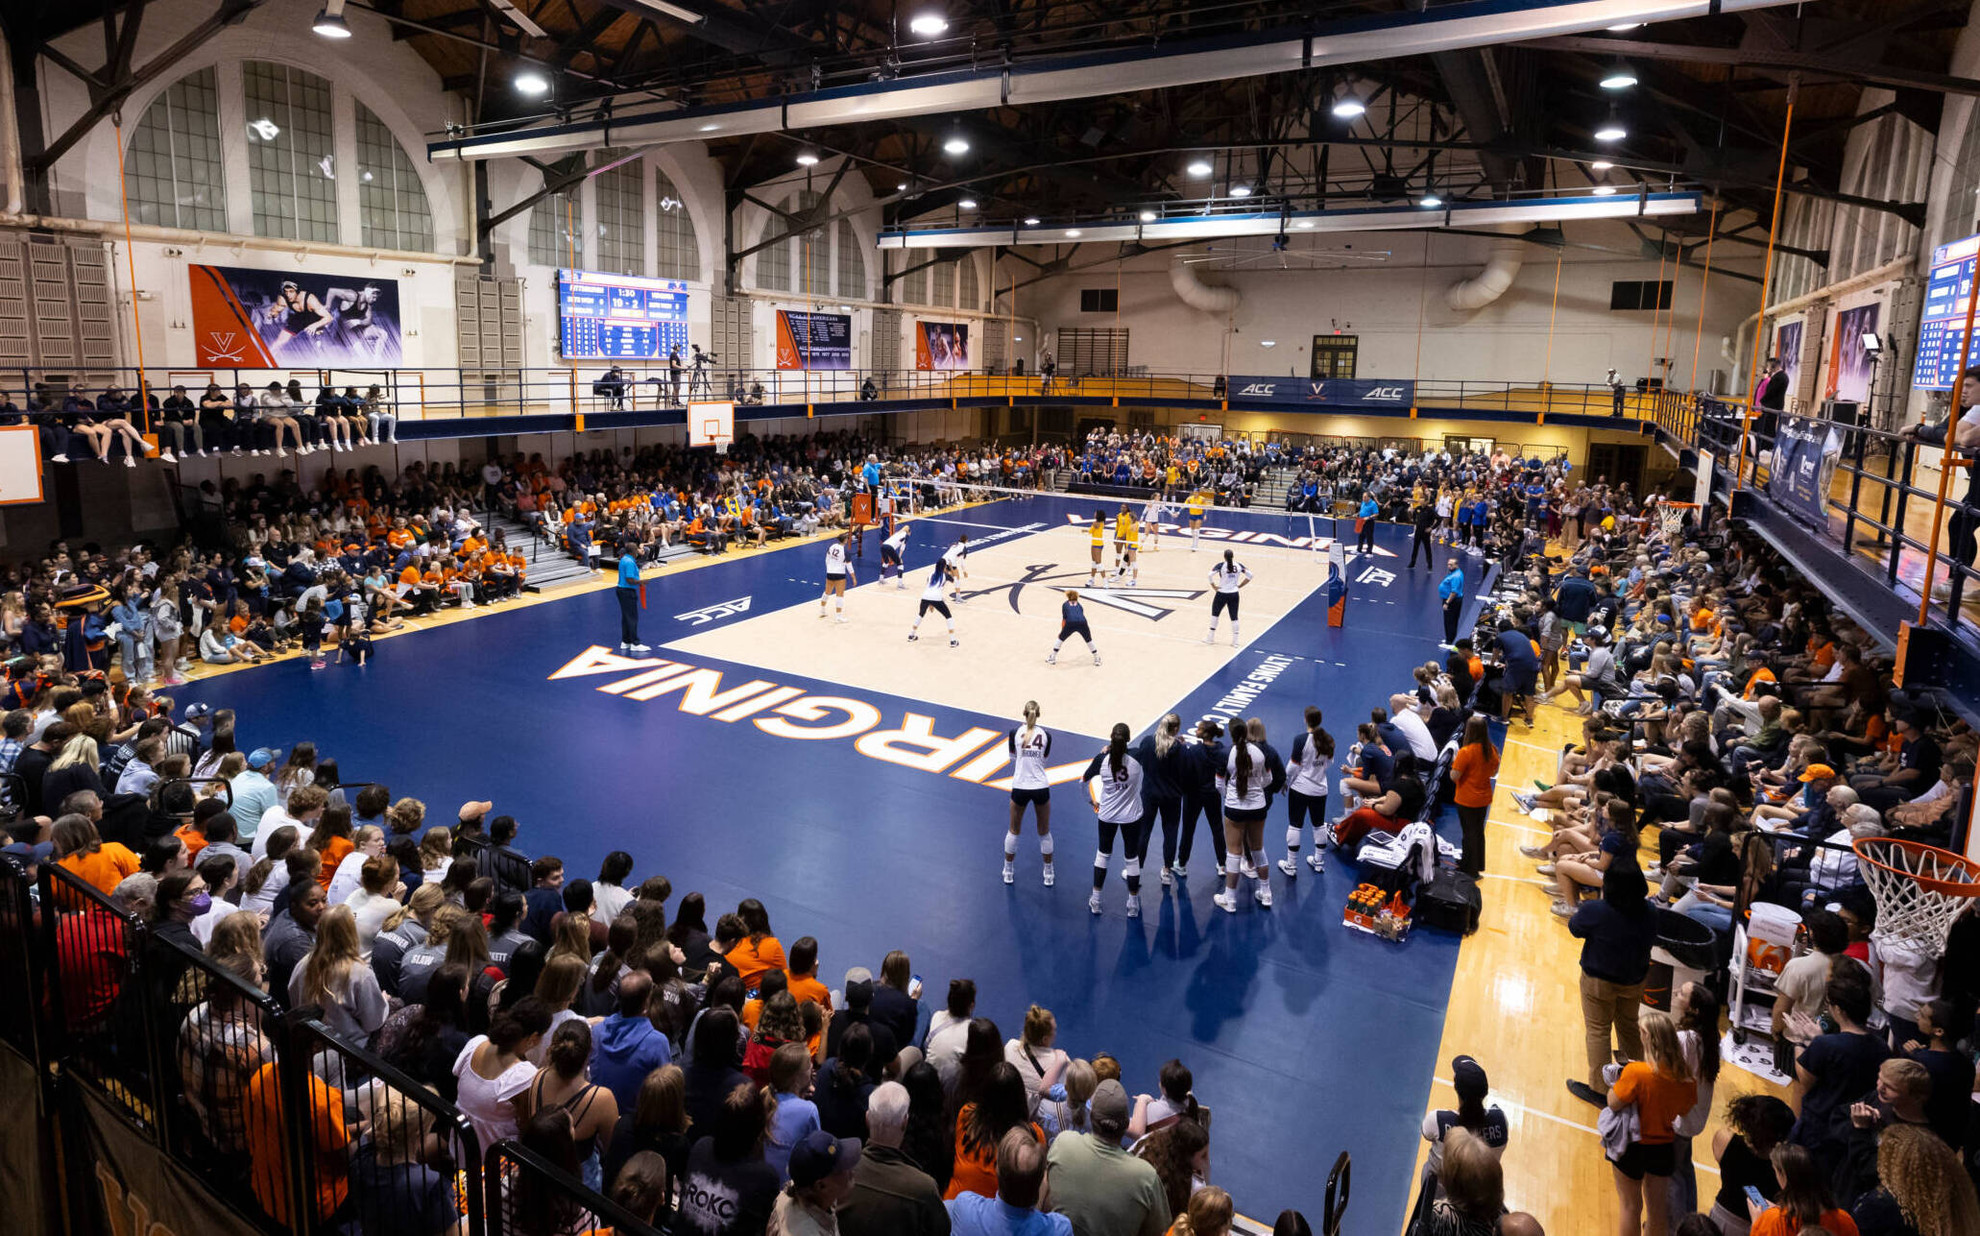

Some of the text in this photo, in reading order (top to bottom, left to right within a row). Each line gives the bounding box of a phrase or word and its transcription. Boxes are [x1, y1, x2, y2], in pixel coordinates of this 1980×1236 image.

[1238, 383, 1276, 396] ACC
[1362, 387, 1405, 400] ACC
[1066, 513, 1399, 558] VRGINIA
[673, 596, 752, 626] ACC
[1211, 655, 1294, 717] LYONS FAMILY
